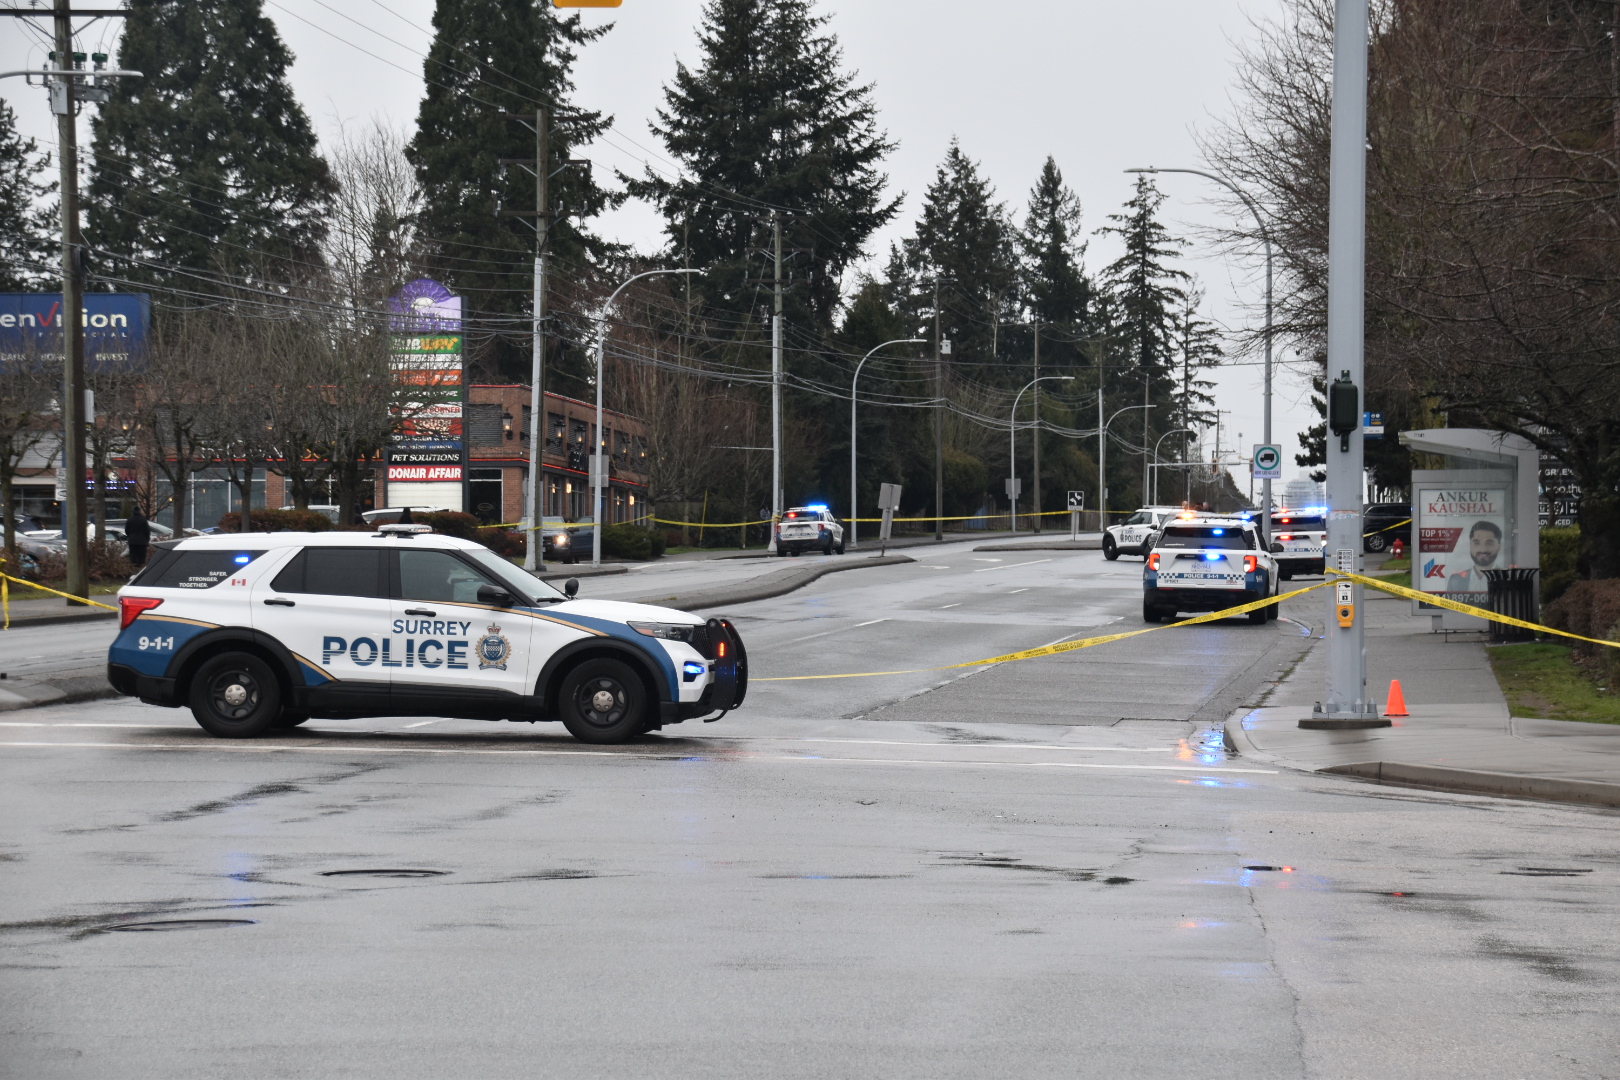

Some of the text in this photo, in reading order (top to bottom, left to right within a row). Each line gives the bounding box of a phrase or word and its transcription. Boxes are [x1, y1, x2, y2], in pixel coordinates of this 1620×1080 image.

[0, 301, 128, 328] enviion
[389, 468, 461, 478] DONAIR AFFAIR
[1436, 491, 1488, 502] ANKUR
[1428, 503, 1496, 513] KAUSHAL
[392, 619, 471, 636] SURREY
[138, 636, 174, 650] 9-1-1
[323, 636, 469, 669] POLICE
